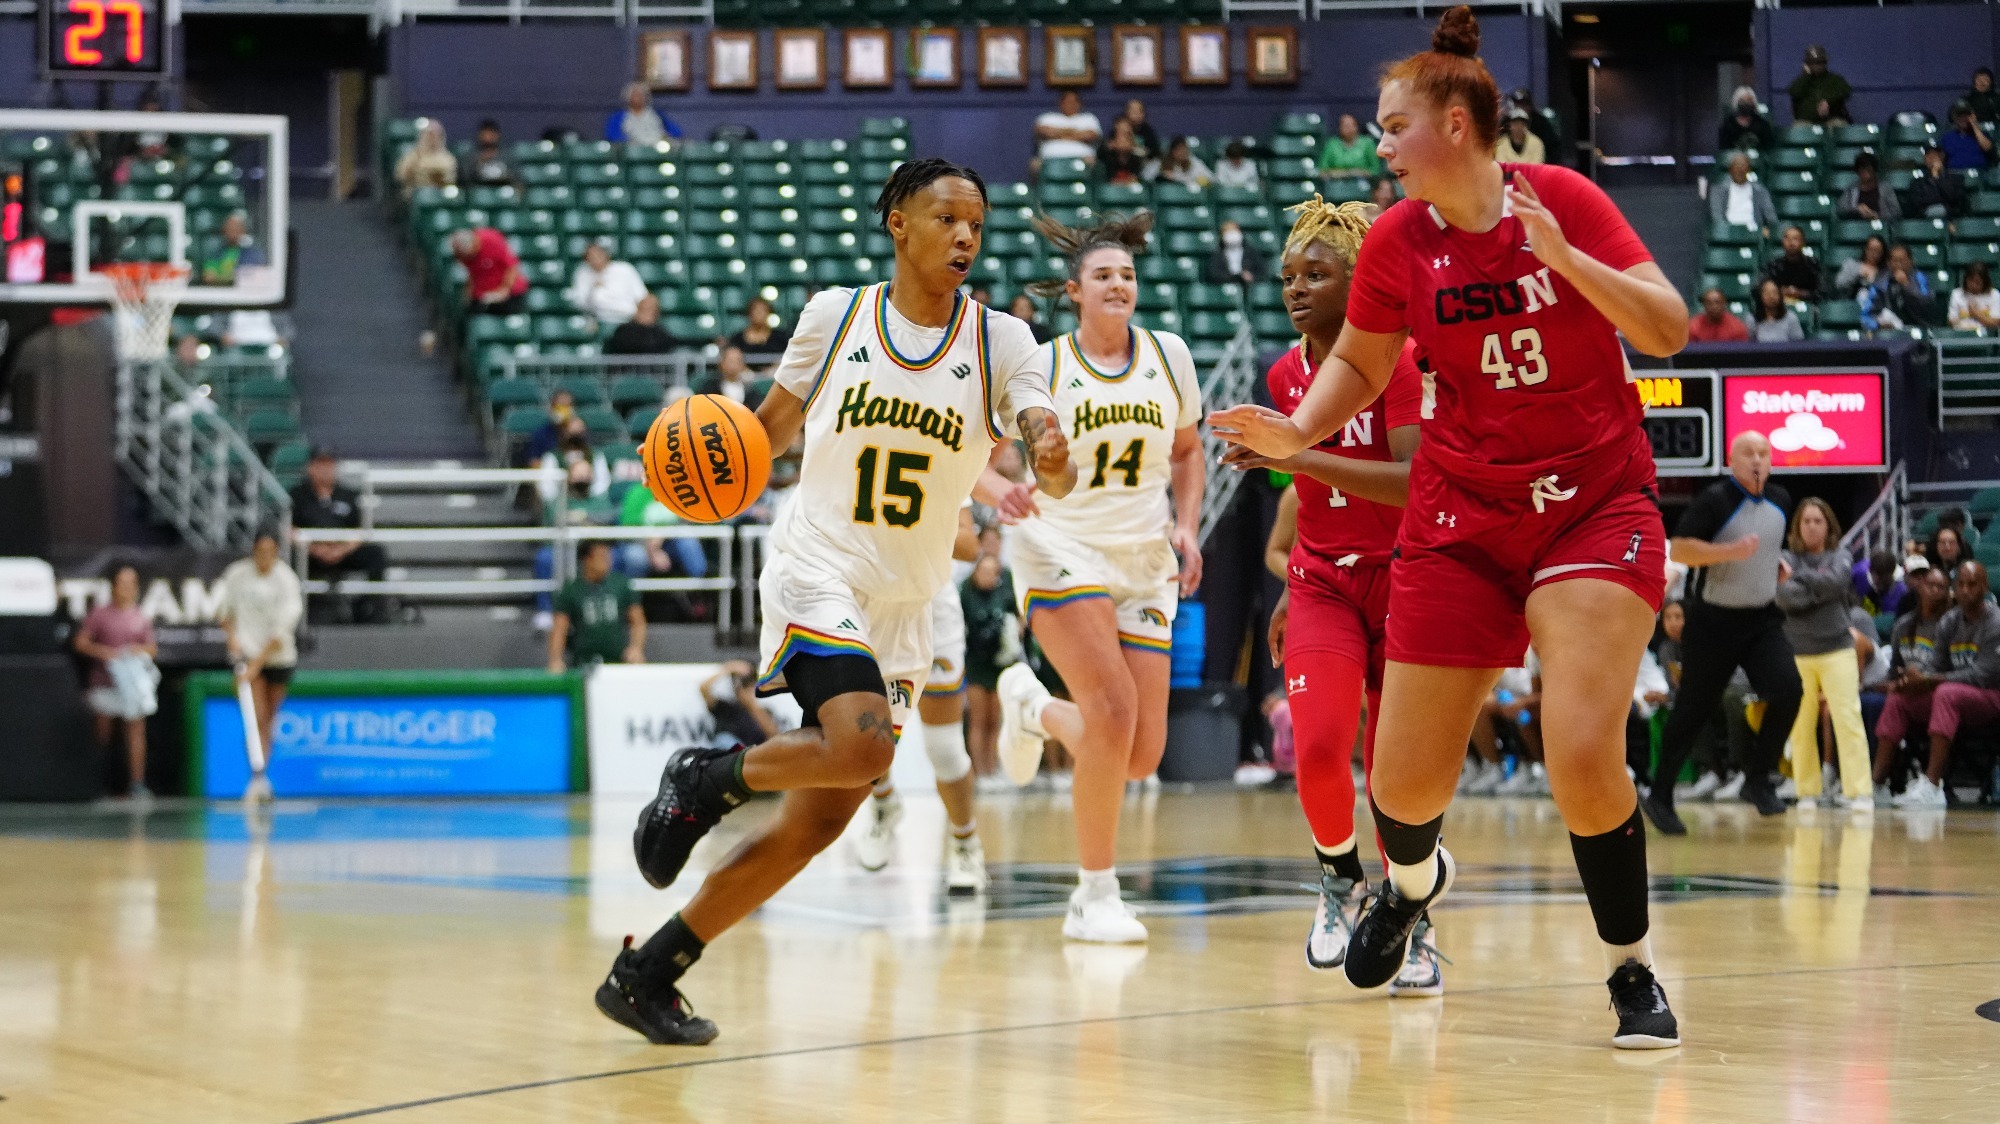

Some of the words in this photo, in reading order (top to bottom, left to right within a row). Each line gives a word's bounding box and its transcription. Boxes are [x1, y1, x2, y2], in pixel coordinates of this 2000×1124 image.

[64, 0, 144, 66] 27
[1435, 266, 1559, 325] CSUN
[1480, 327, 1549, 390] 43
[835, 380, 964, 452] Hawaii
[1073, 398, 1165, 439] Hawaii
[665, 420, 700, 509] Wilson
[700, 421, 734, 486] NCAA
[1089, 437, 1145, 489] 14
[853, 444, 933, 530] 15
[275, 709, 497, 745] OUTRIGGER
